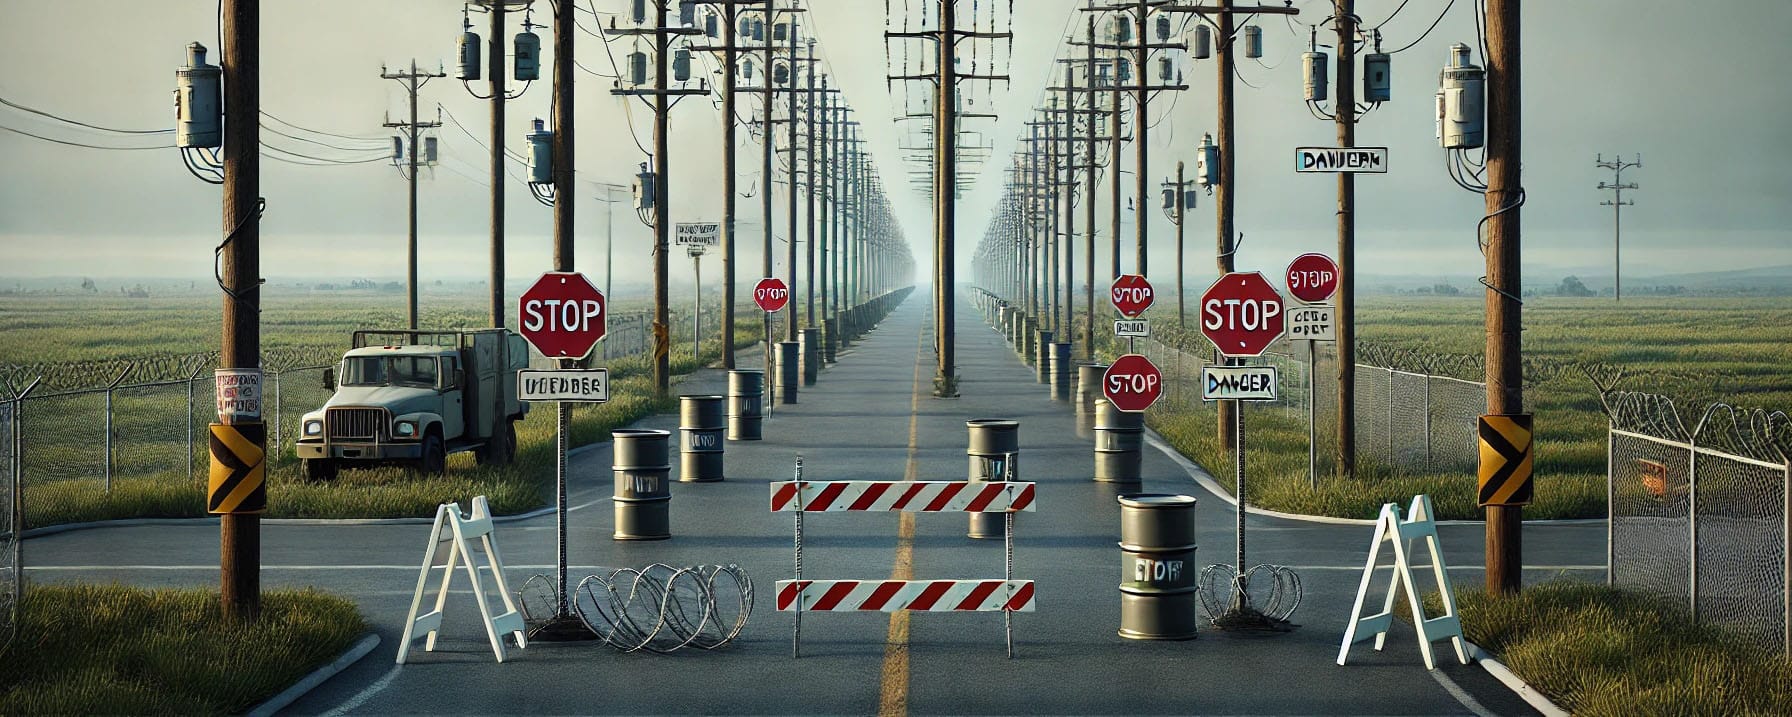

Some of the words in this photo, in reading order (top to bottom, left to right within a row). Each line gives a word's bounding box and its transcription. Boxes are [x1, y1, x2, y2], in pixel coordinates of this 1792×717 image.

[524, 299, 601, 332] STOP
[1204, 298, 1280, 331] STOP
[1109, 373, 1158, 394] STOP
